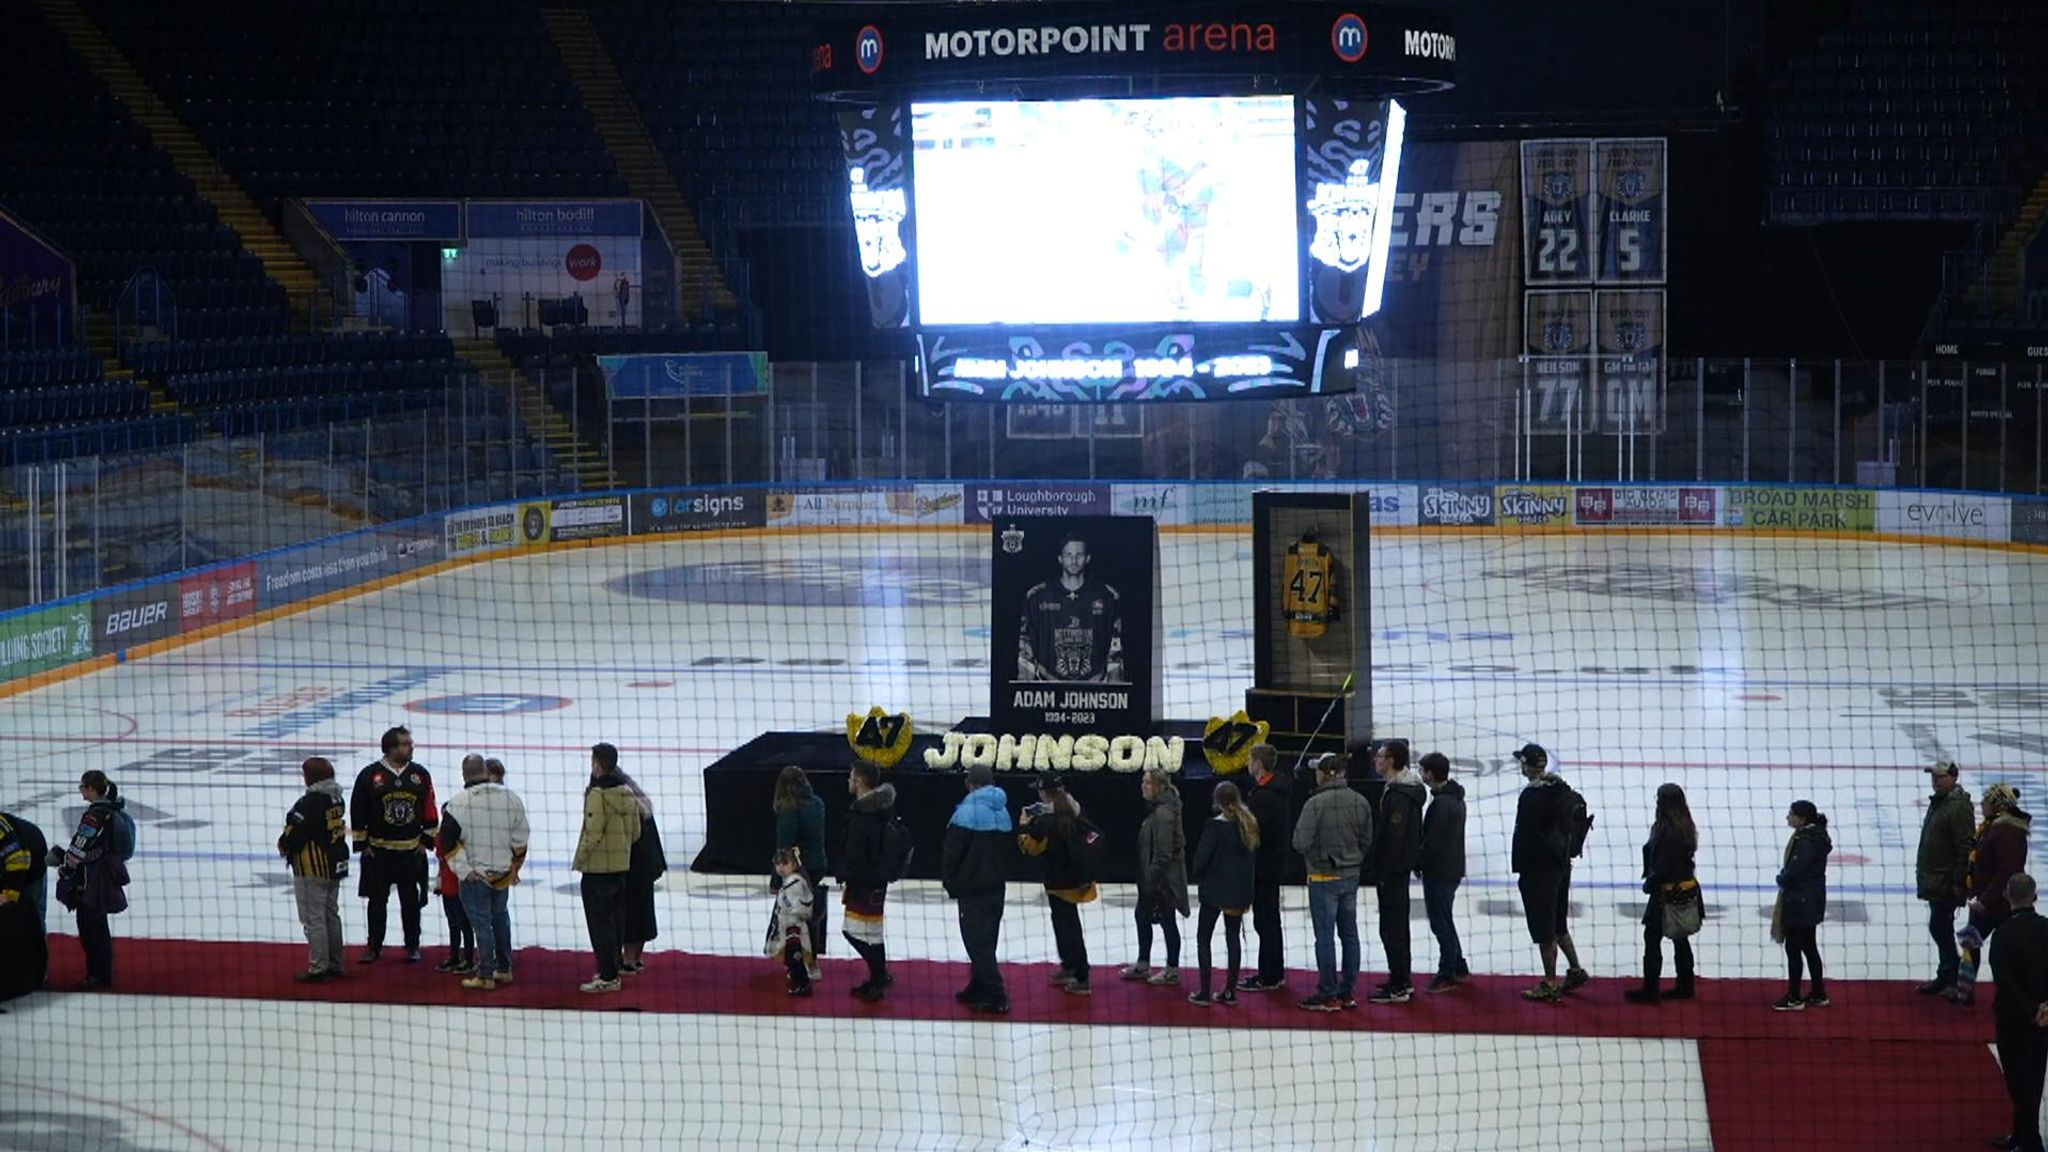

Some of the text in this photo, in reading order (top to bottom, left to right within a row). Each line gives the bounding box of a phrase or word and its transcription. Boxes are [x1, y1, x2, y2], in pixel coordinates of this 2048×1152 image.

[925, 23, 1275, 59] MOTORPOINT arena
[345, 208, 425, 222] hilton cannon
[516, 207, 594, 221] hilton bodill
[1609, 209, 1651, 222] CLARKE
[1538, 228, 1577, 271] 22
[1620, 228, 1640, 271] 5
[569, 257, 597, 268] work
[1935, 344, 1959, 355] HOME
[1536, 360, 1581, 374] NEILSON
[1537, 378, 1580, 422] 77
[674, 494, 744, 517] arsigns
[803, 497, 822, 510] All
[1007, 490, 1096, 504] Loughborough
[1423, 494, 1490, 517] SKINNY
[1502, 496, 1566, 516] SKINNY
[1729, 490, 1869, 509] BROAD MARSH
[1007, 504, 1070, 516] University
[1752, 509, 1847, 529] CAR PARK
[1907, 499, 1984, 526] evolve
[266, 569, 301, 593] Freedom
[302, 565, 322, 583] costs
[355, 553, 369, 573] you
[1290, 569, 1323, 604] 47
[105, 601, 167, 636] BAUER
[31, 625, 68, 661] SOCIETY
[1013, 691, 1128, 709] ADAM JOHNSON
[1045, 711, 1096, 724] 1994-2023
[856, 716, 911, 749] 47
[1205, 720, 1261, 755] 47
[923, 731, 1185, 774] JOHNSON
